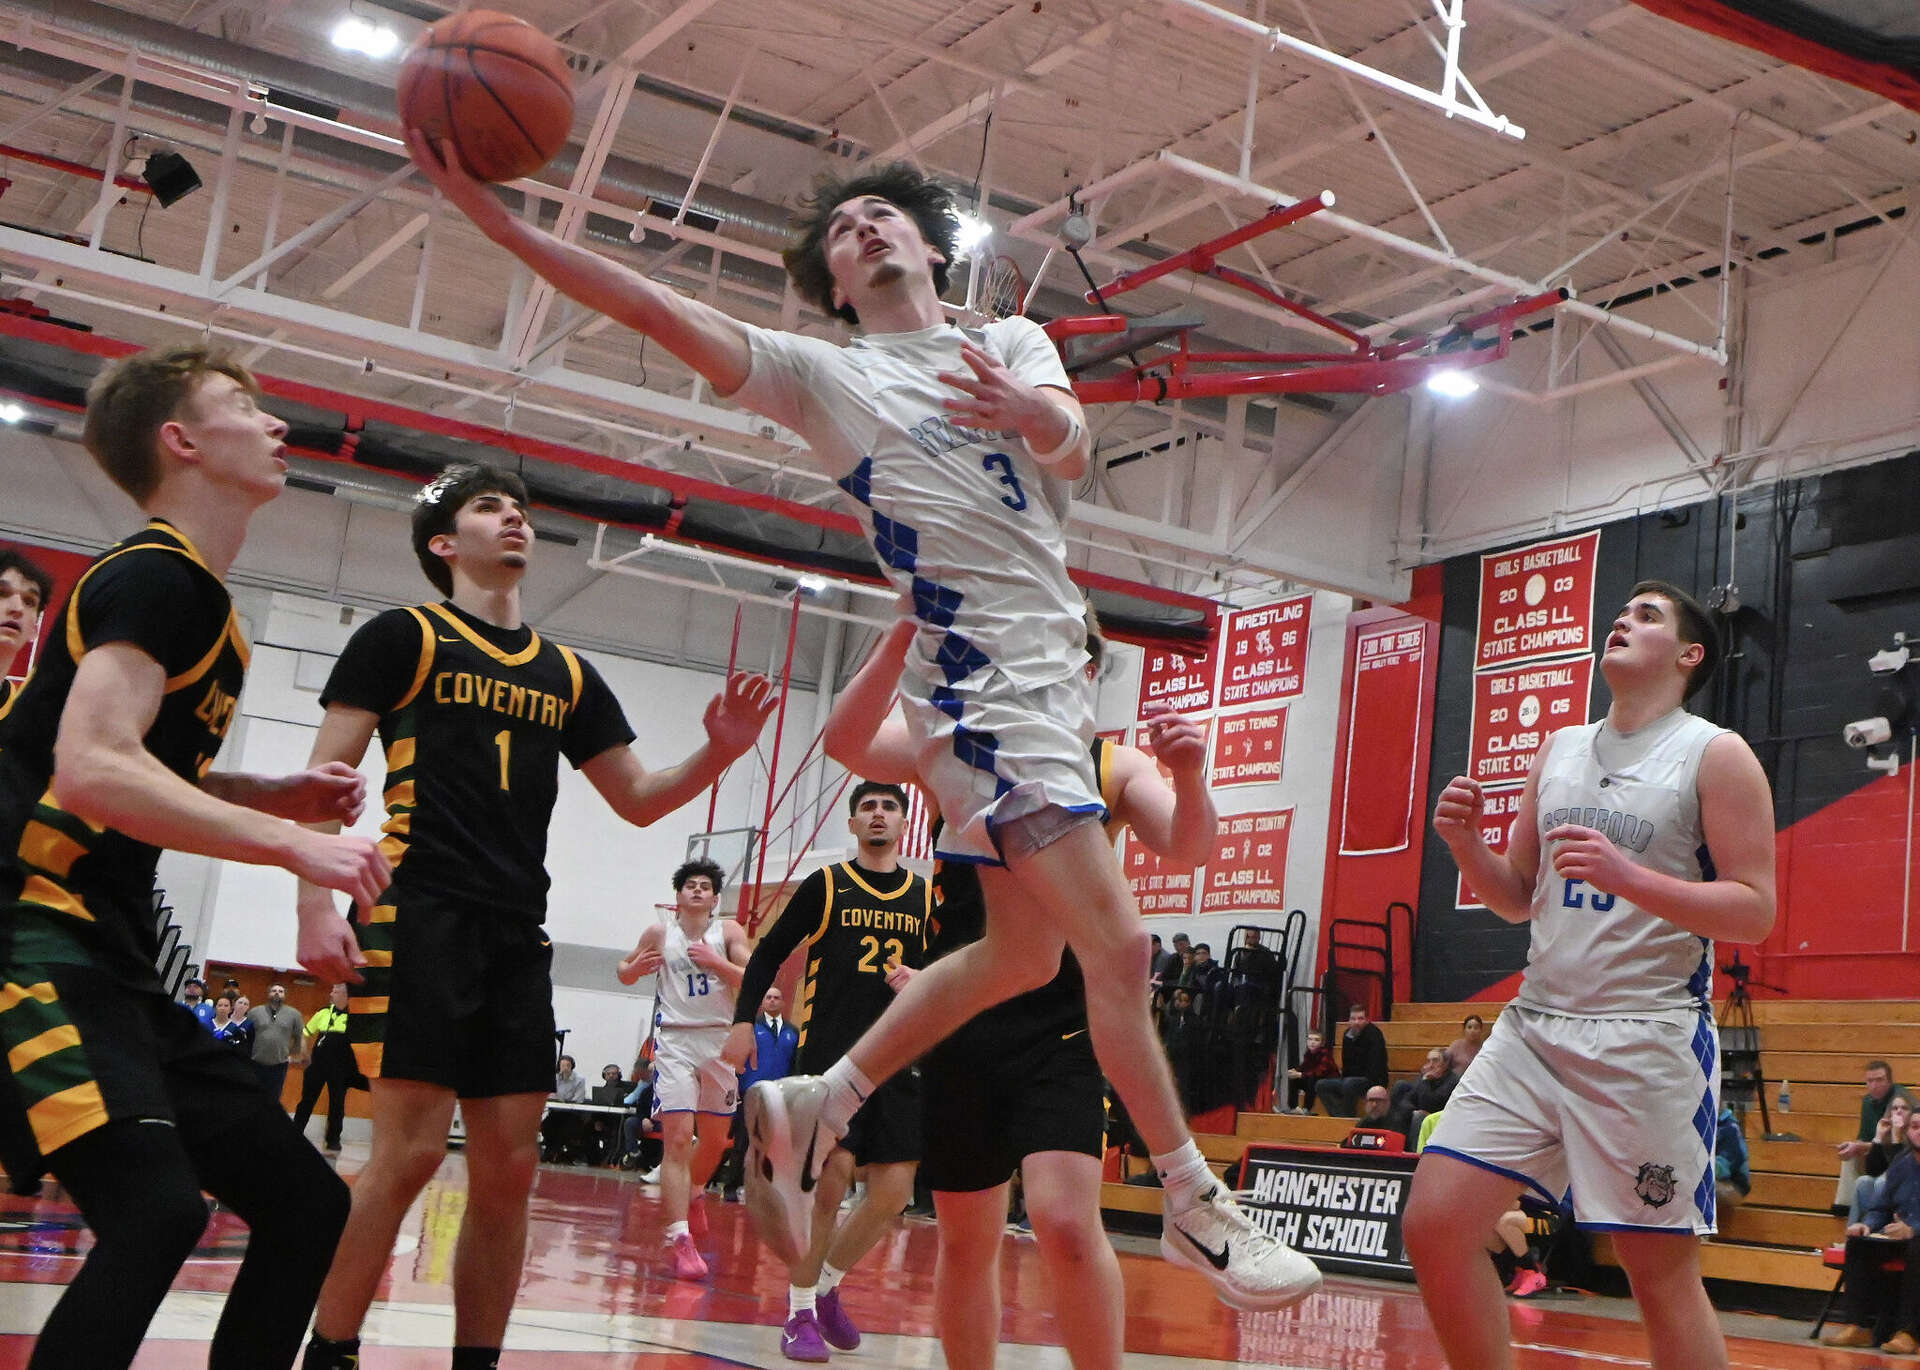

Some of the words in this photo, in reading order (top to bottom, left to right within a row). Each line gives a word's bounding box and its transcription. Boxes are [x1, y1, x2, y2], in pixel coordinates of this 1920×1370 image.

[982, 453, 1027, 512] 3
[1494, 558, 1520, 578] GIRLS
[1523, 545, 1581, 572] BASKETBALL
[1499, 588, 1518, 604] 20
[1553, 576, 1574, 593] 03
[1235, 604, 1304, 631] WRESTLING
[1493, 609, 1548, 634] CLASS
[1551, 605, 1575, 624] LL
[1235, 640, 1248, 656] 19
[1482, 637, 1517, 658] STATE
[1520, 626, 1584, 651] CHAMPIONS
[1152, 656, 1164, 672] 19
[1232, 660, 1274, 681] CLASS
[1276, 656, 1293, 673] LL
[1149, 676, 1186, 696] CLASS
[1188, 673, 1205, 689] LL
[1224, 683, 1250, 701] STATE
[1251, 674, 1300, 696] CHAMPIONS
[1490, 676, 1515, 696] GIRLS
[1518, 668, 1574, 692] BASKETBALL
[435, 671, 570, 731] COVENTRY
[1550, 698, 1570, 715] 05
[1224, 719, 1246, 734] BOYS
[1248, 715, 1279, 731] TENNIS
[1489, 707, 1508, 723] 20
[1487, 731, 1539, 754] CLASS
[494, 729, 512, 791] 1
[1213, 765, 1236, 780] STATE
[1237, 761, 1281, 777] CHAMPIONS
[1478, 756, 1511, 776] STATE
[1482, 826, 1502, 845] 20
[1221, 847, 1236, 860] 20
[1257, 843, 1272, 857] 02
[1214, 869, 1255, 888] CLASS
[1256, 869, 1274, 884] LL
[1203, 891, 1231, 907] STATE
[1233, 889, 1281, 905] CHAMPIONS
[841, 908, 921, 936] COVENTRY
[858, 935, 904, 973] 23
[687, 973, 709, 996] 13
[1252, 1168, 1402, 1215] MANCHESTER
[1303, 1214, 1389, 1258] SCHOOL
